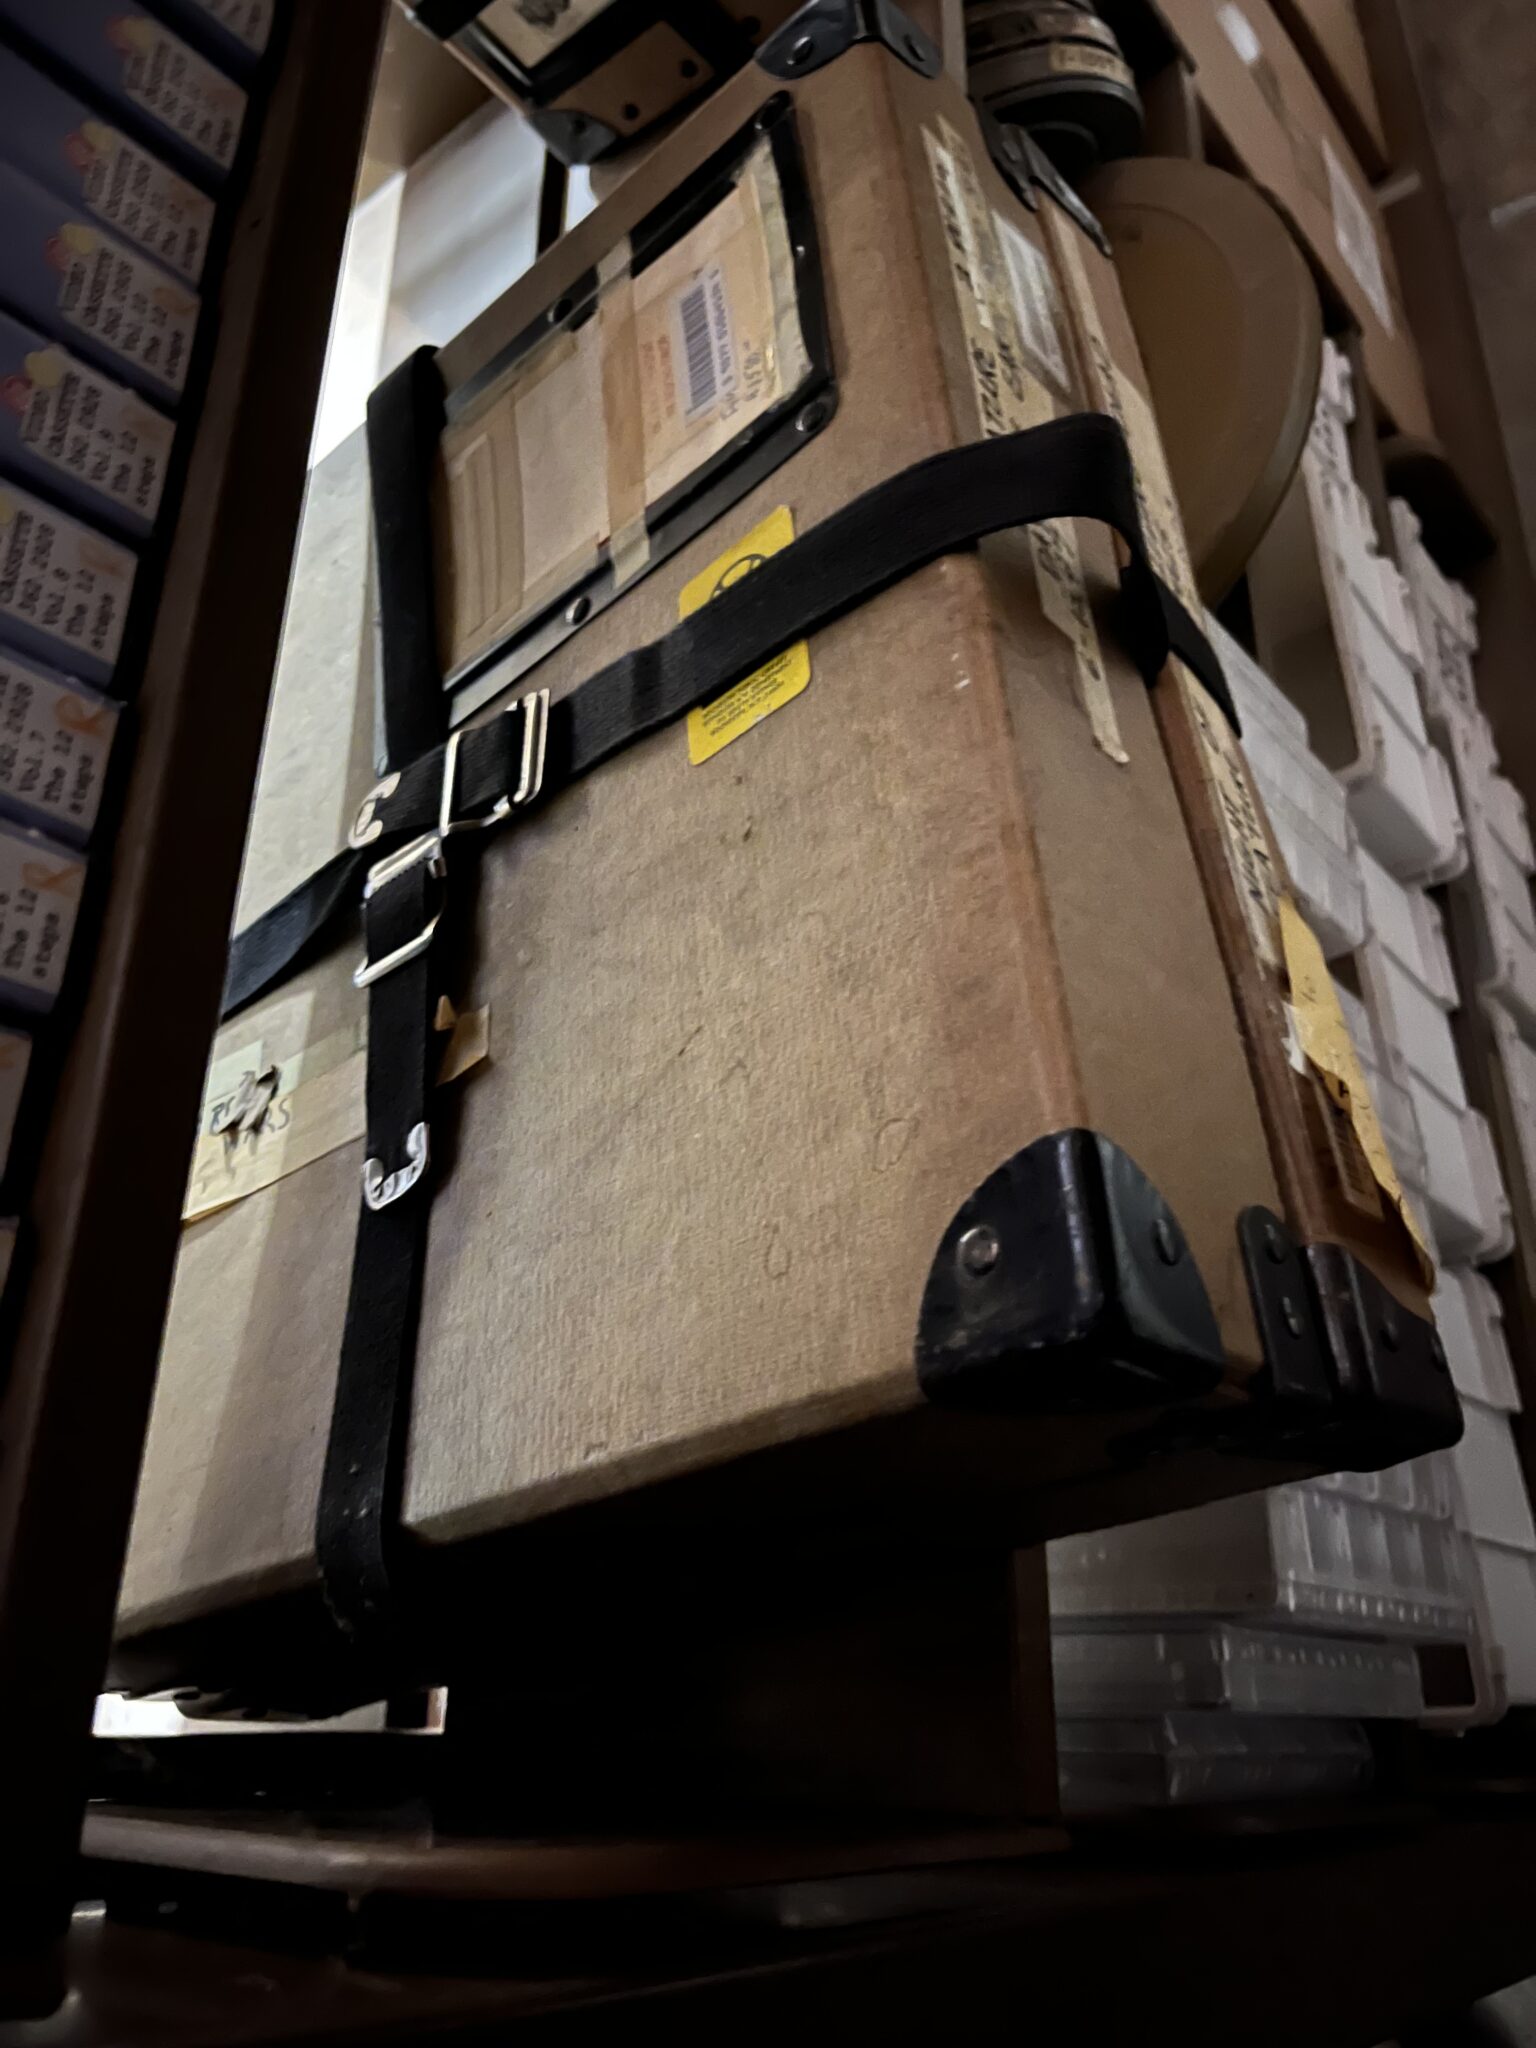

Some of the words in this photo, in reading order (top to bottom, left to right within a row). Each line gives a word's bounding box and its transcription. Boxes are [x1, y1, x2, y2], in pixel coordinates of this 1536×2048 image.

[165, 328, 186, 380] steps
[46, 371, 81, 459] CASSETTE
[111, 463, 132, 493] The
[136, 455, 156, 508] steps
[64, 603, 89, 638] The
[89, 592, 116, 650] steps
[52, 729, 74, 756] 12
[42, 766, 67, 804] The
[69, 754, 94, 815] steps
[15, 888, 39, 916] 12
[3, 928, 30, 970] The
[32, 911, 60, 977] steps
